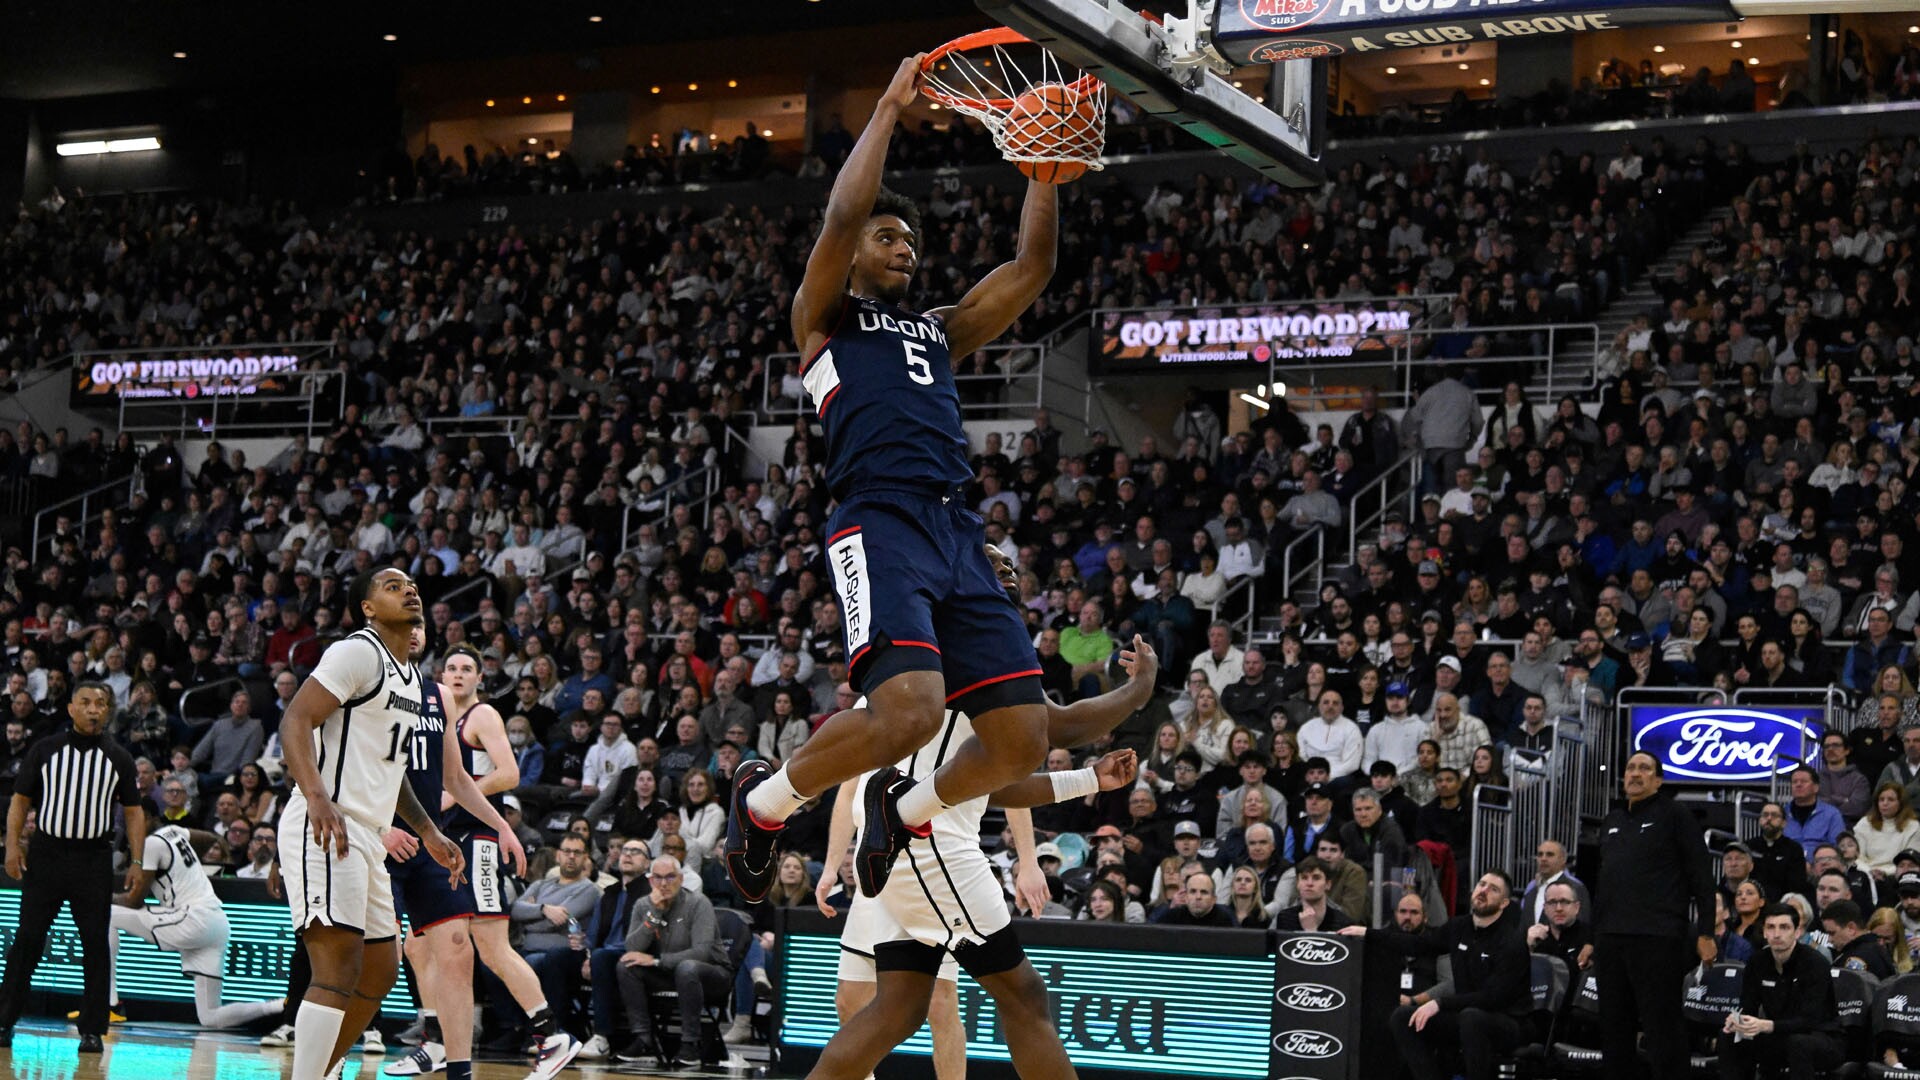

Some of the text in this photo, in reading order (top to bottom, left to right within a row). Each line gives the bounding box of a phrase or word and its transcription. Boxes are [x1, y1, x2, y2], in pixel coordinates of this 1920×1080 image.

[1270, 16, 1297, 25] SUBS
[1351, 14, 1620, 52] A SUB ABOVE
[1120, 319, 1183, 347] GOT
[91, 361, 136, 384] GOT
[902, 339, 935, 386] 5
[839, 544, 860, 647] HUSKIES
[383, 722, 415, 766] 14
[411, 736, 428, 771] 11
[1669, 717, 1785, 768] Ford
[480, 844, 495, 908] HUSKIES
[1291, 939, 1337, 962] Ford
[1287, 985, 1334, 1009] Ford
[1684, 1001, 1719, 1012] MEDICAL
[1887, 1012, 1920, 1022] MEDICA
[1284, 1032, 1331, 1056] Ford
